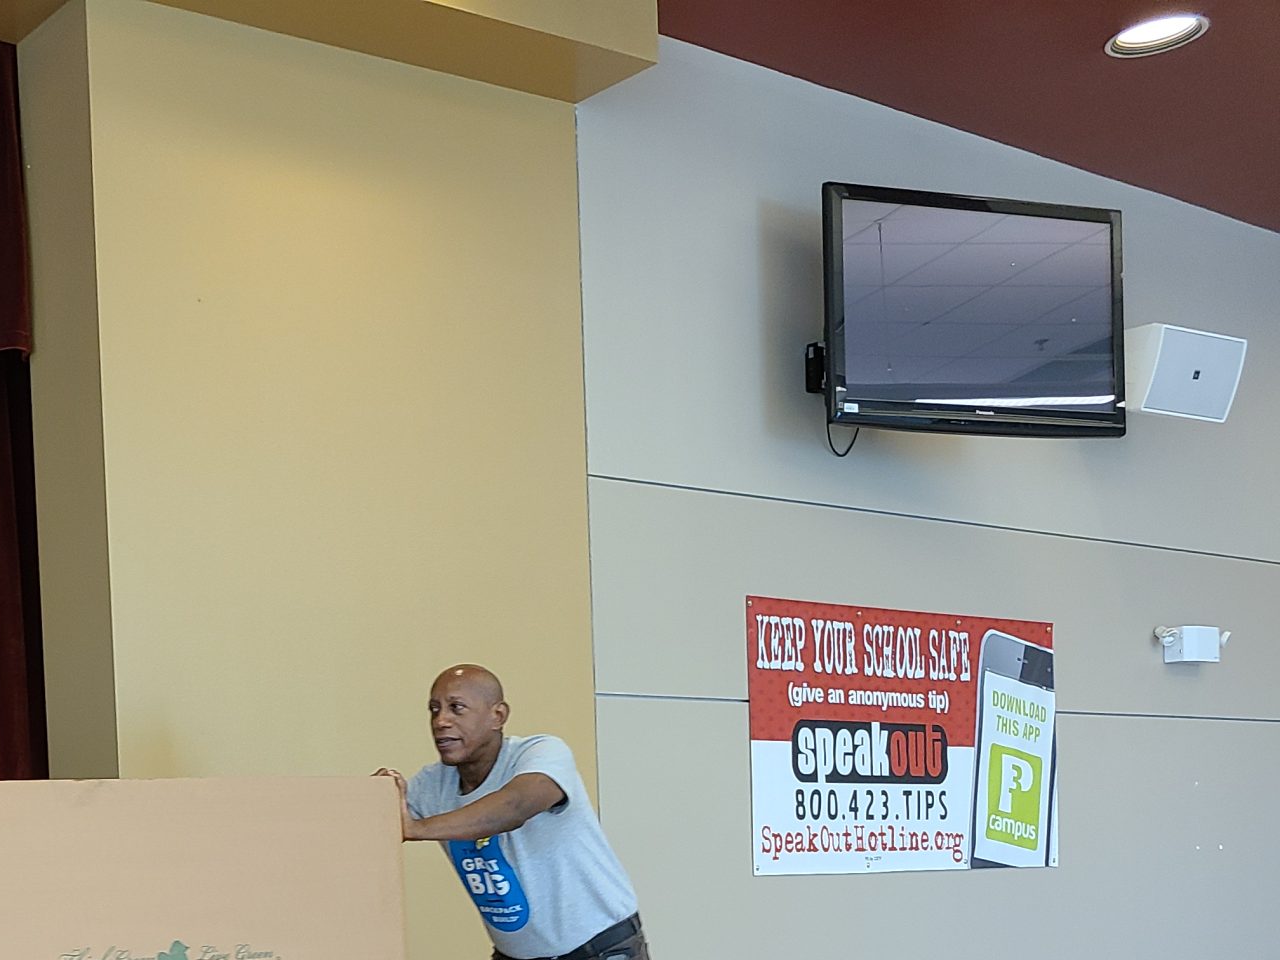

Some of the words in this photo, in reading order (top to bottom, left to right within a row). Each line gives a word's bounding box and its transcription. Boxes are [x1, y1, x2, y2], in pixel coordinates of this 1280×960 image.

[755, 614, 806, 672] KEEP
[811, 618, 859, 675] YOUR
[863, 623, 925, 680] SCHOOL
[928, 628, 971, 682] SAFE
[787, 681, 825, 707] (give
[827, 688, 845, 704] an
[848, 689, 926, 711] anonymous
[927, 690, 950, 714] tip)
[992, 690, 1047, 723] DOWNLOAD
[996, 715, 1019, 737] THIS
[1022, 722, 1041, 743] APP
[795, 789, 948, 820] 800.423.TIPS
[989, 814, 1036, 840] campus
[761, 825, 965, 862] SpeakOutHotline.org
[465, 871, 511, 896] BIG
